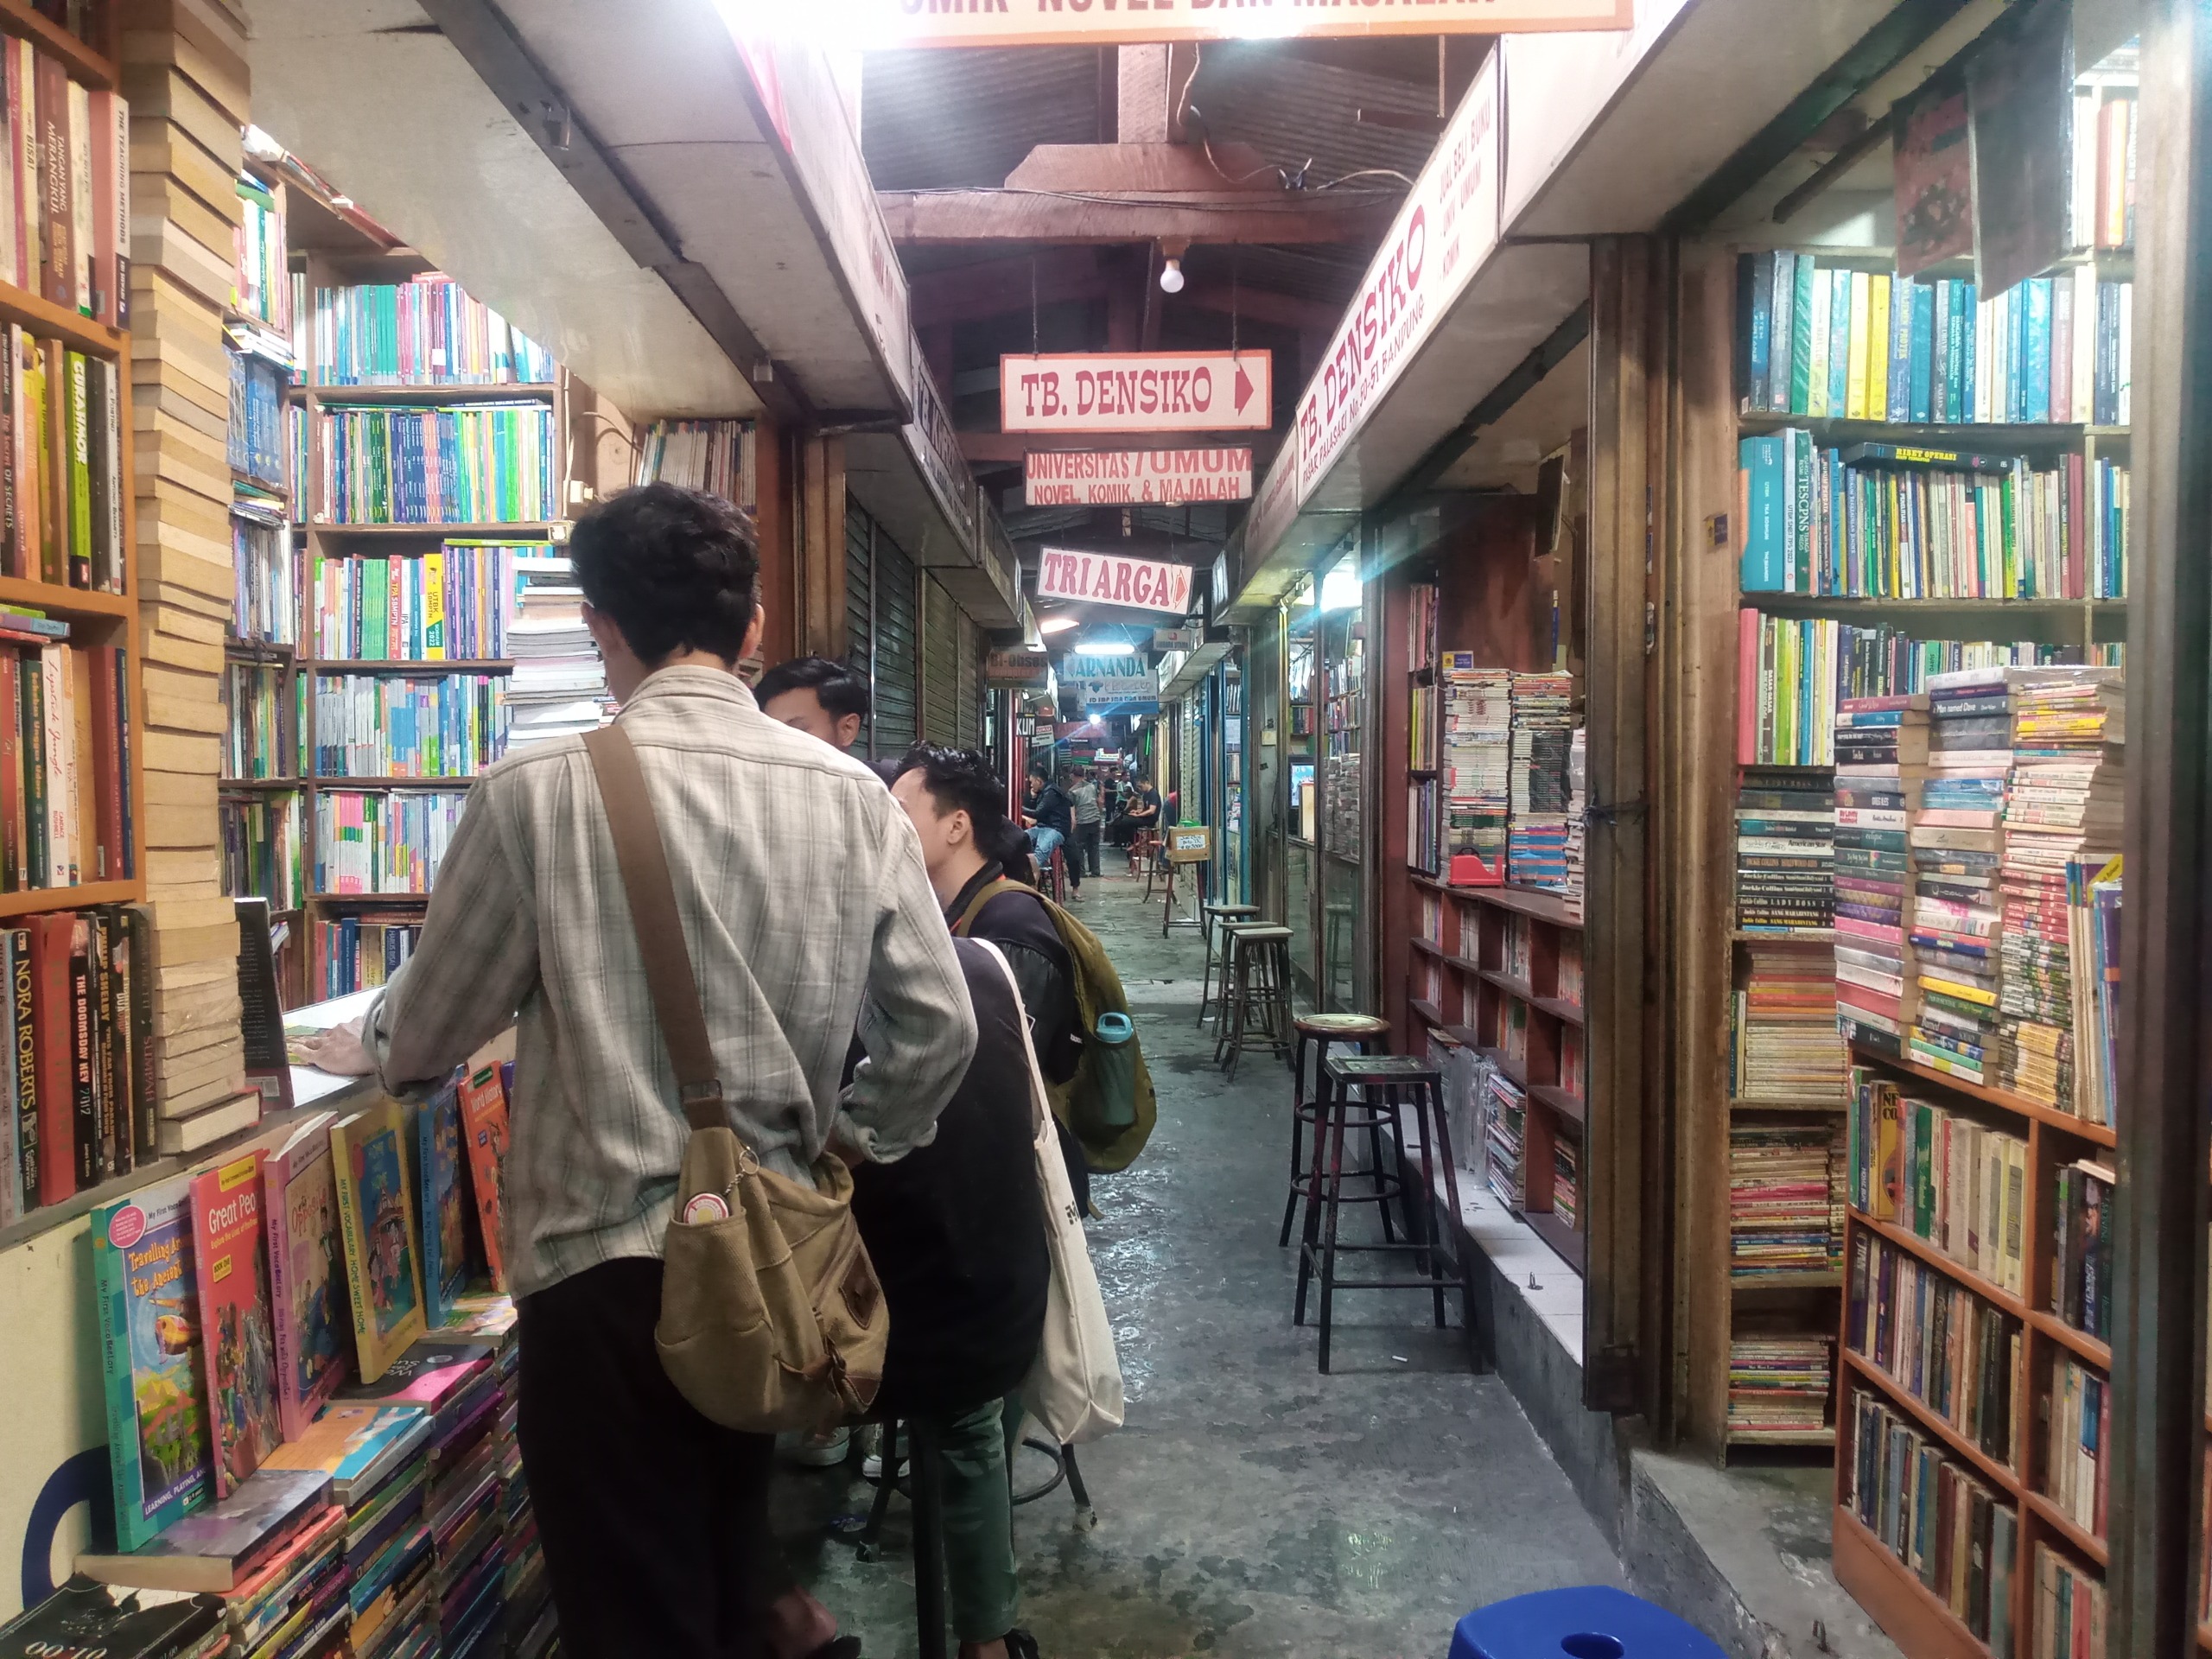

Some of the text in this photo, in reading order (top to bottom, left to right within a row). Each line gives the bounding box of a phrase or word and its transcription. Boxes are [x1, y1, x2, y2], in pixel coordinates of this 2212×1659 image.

[1300, 205, 1425, 462] TB. DENSIKO
[1382, 294, 1425, 375] BANDUNG
[1021, 366, 1211, 416] TB. DENSIKO
[73, 360, 88, 466] CURAHMOR
[1150, 448, 1251, 474] UMUM
[1896, 448, 1957, 461] RISET OPERASI
[4, 468, 13, 484] OF
[1141, 480, 1154, 501] &
[1160, 476, 1240, 502] MAJALAH
[4, 486, 14, 530] SECRETS
[1936, 702, 1976, 713] Man named Dave
[1788, 839, 1815, 848] American
[99, 926, 111, 1021] PHILIP SHELBY
[16, 959, 36, 1109] NORA ROBERTS
[76, 975, 91, 1116] THE DOOMSDAY KEY 2012
[143, 1035, 156, 1103] SUMPAH
[208, 1199, 238, 1235] Great
[238, 1192, 258, 1219] Peo
[343, 1212, 355, 1256] VOCABULARY
[129, 1242, 170, 1272] Travelling
[349, 1260, 359, 1283] HOME
[99, 1279, 111, 1293] My
[131, 1260, 183, 1296] the Ancient
[101, 1295, 111, 1316] First
[353, 1284, 363, 1309] SWEET
[355, 1311, 365, 1335] HOME
